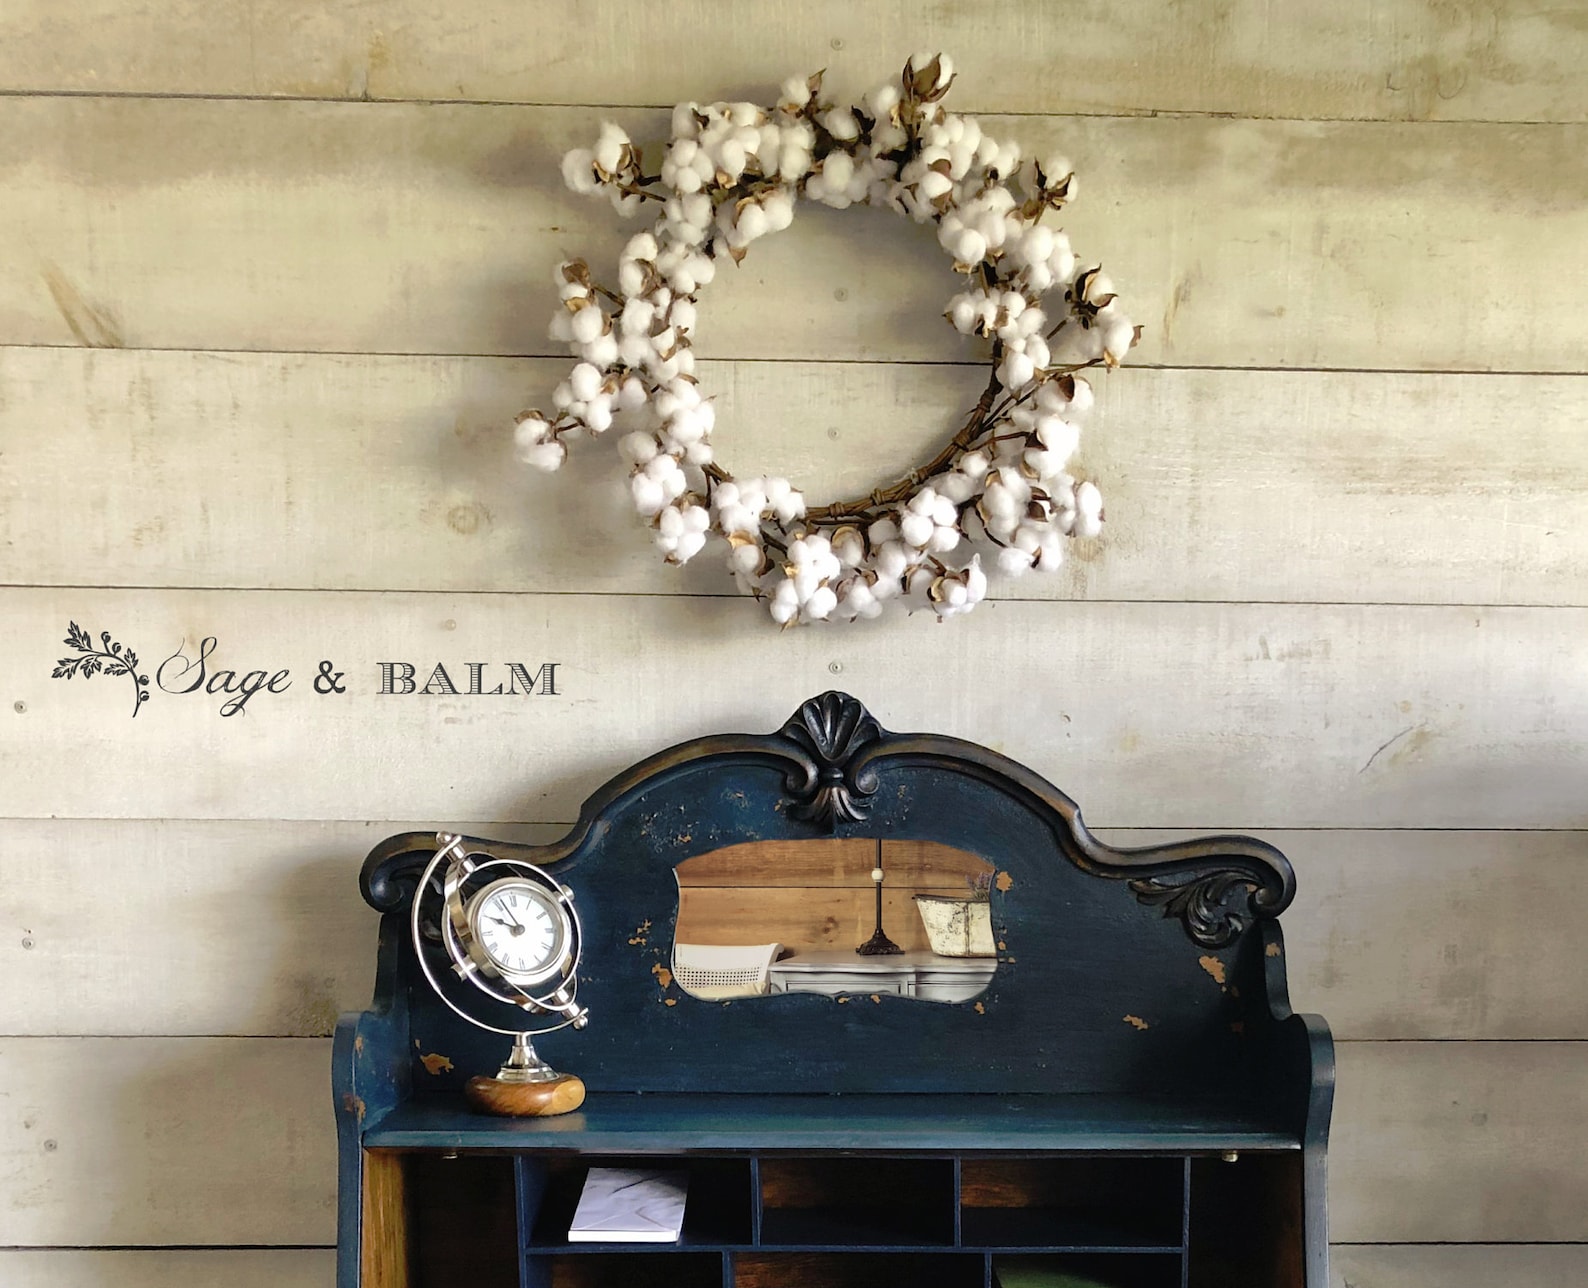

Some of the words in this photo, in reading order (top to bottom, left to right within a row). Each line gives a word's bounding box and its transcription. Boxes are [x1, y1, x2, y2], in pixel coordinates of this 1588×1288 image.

[156, 635, 291, 716] Sage
[313, 659, 346, 694] &
[376, 661, 561, 695] BALM
